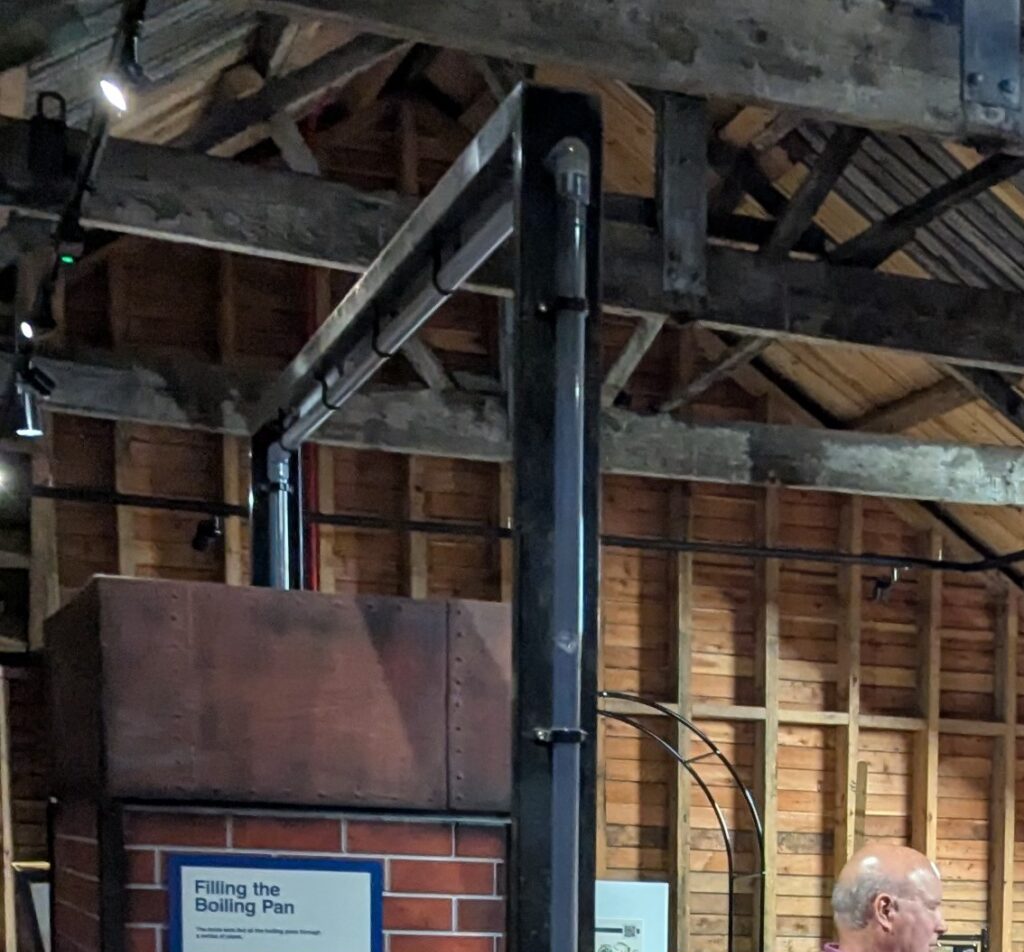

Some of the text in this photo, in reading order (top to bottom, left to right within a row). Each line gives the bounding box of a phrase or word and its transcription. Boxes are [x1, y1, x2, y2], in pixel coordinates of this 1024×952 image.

[194, 880, 280, 899] Filling the
[194, 897, 294, 917] Boiling Pan
